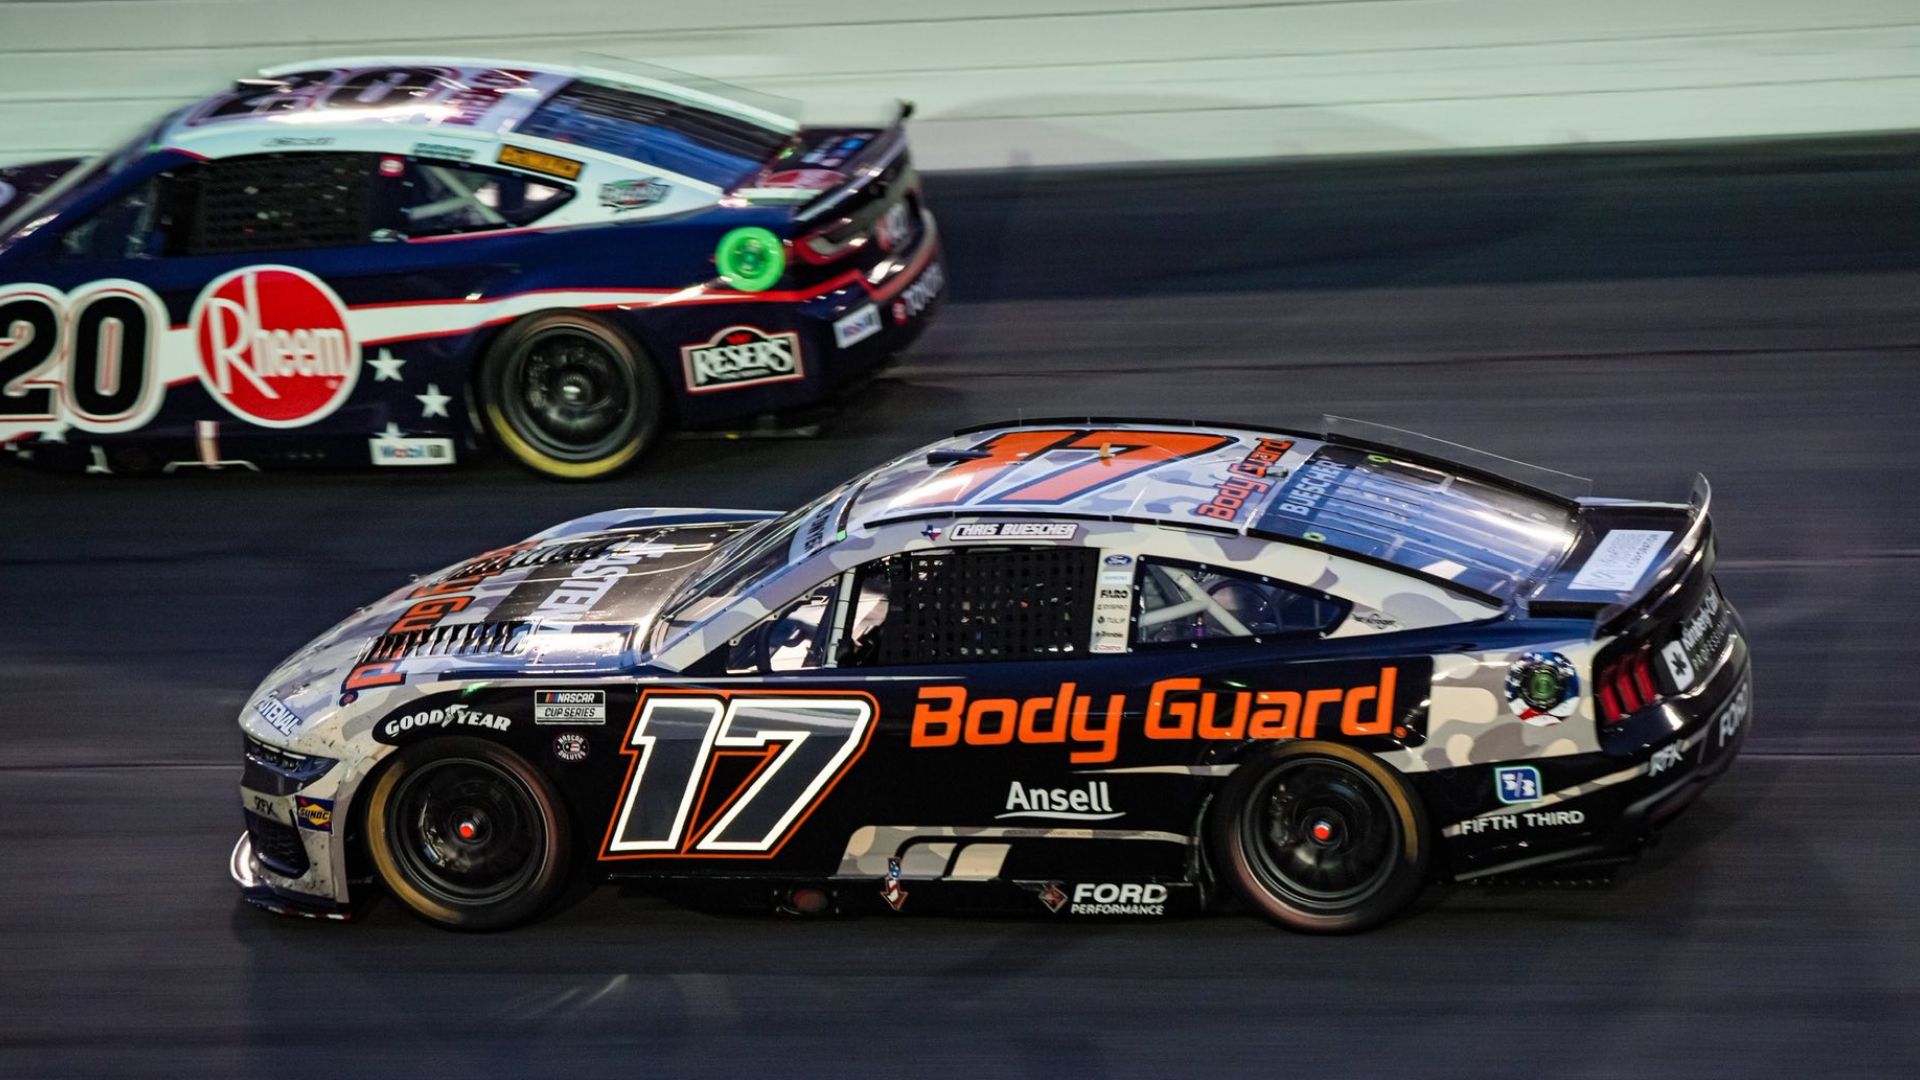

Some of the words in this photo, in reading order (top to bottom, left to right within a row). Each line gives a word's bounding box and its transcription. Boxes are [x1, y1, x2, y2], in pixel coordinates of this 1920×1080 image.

[203, 272, 346, 399] Rheem
[1196, 475, 1272, 522] Body
[1278, 458, 1347, 517] BUESCHER
[956, 523, 1000, 537] CHRIS
[1000, 523, 1077, 537] BUESCHER
[1100, 588, 1129, 599] FARO
[557, 693, 595, 704] NASCAR
[544, 707, 563, 717] CUP
[563, 707, 596, 717] SERIES
[910, 682, 1126, 764] Body
[598, 689, 880, 861] 17
[1005, 781, 1113, 812] Ansell
[1460, 814, 1518, 835] FIFTH
[1522, 810, 1585, 827] THIRD
[1072, 883, 1168, 904] FORD
[1070, 903, 1165, 915] PERFORMANCE
